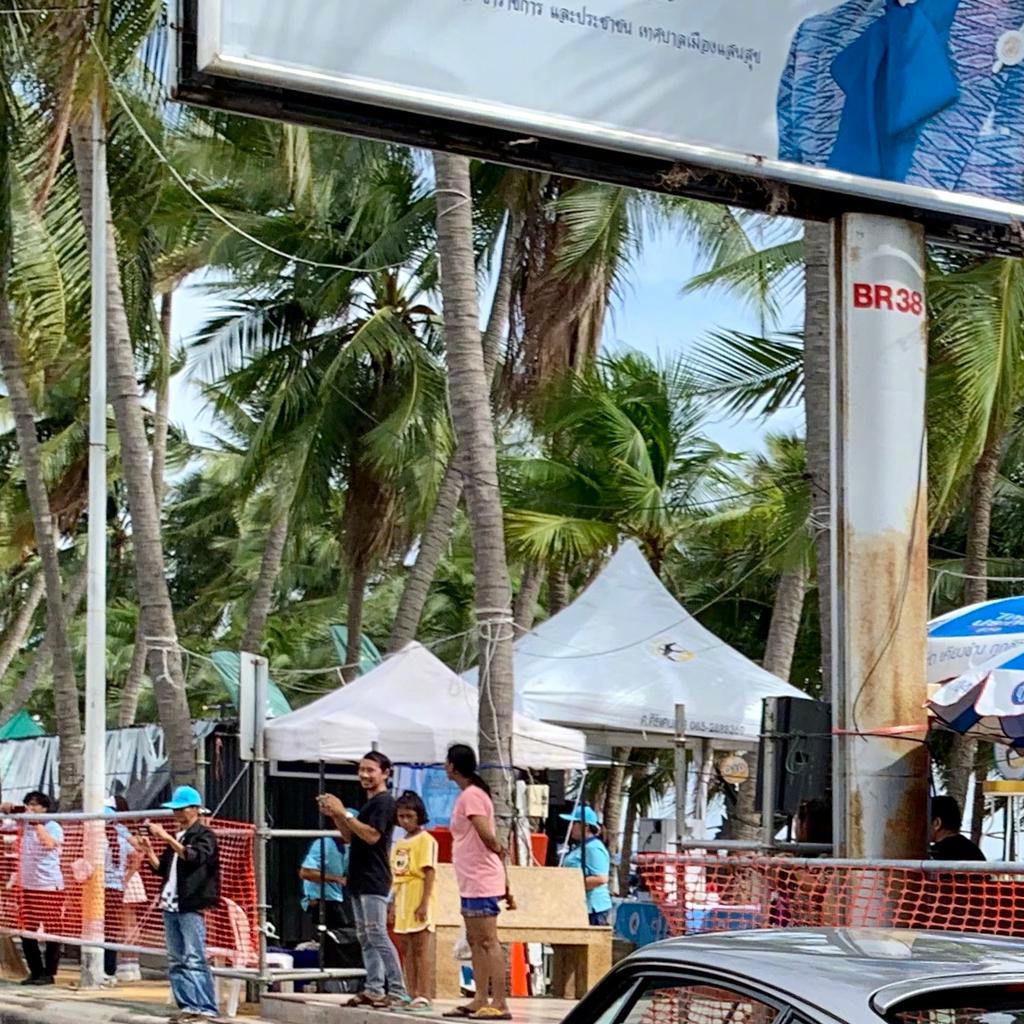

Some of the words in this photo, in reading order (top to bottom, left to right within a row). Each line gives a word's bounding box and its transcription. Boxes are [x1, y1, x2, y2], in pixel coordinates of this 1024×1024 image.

[551, 5, 631, 34] และประชาชน
[639, 24, 761, 71] เทศบาลเมืองแสนสุข
[853, 283, 923, 315] BR38
